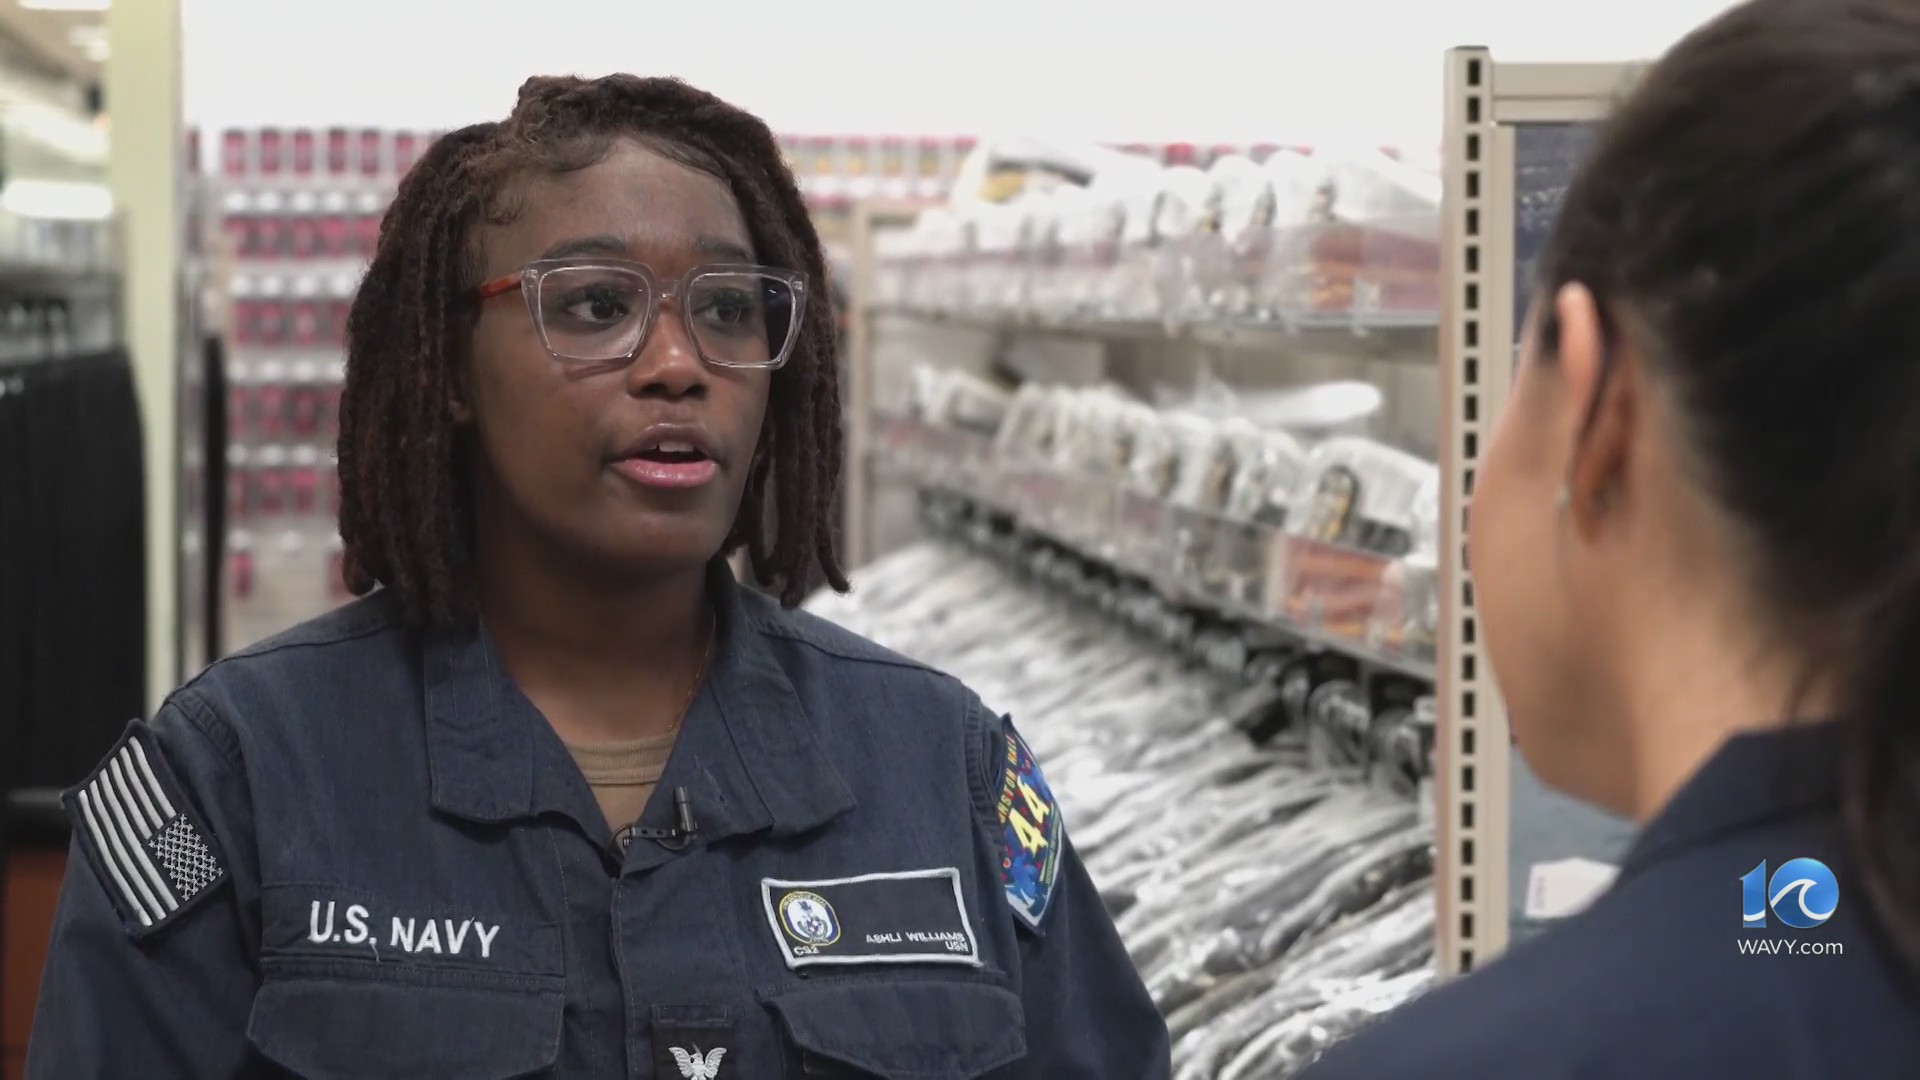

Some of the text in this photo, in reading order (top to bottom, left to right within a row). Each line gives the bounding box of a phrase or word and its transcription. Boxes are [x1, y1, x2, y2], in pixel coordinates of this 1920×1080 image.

[1008, 775, 1049, 857] 44
[308, 900, 500, 958] U.S. NAVY
[866, 931, 966, 943] ASHLI WILLIAMS
[945, 940, 969, 952] USN
